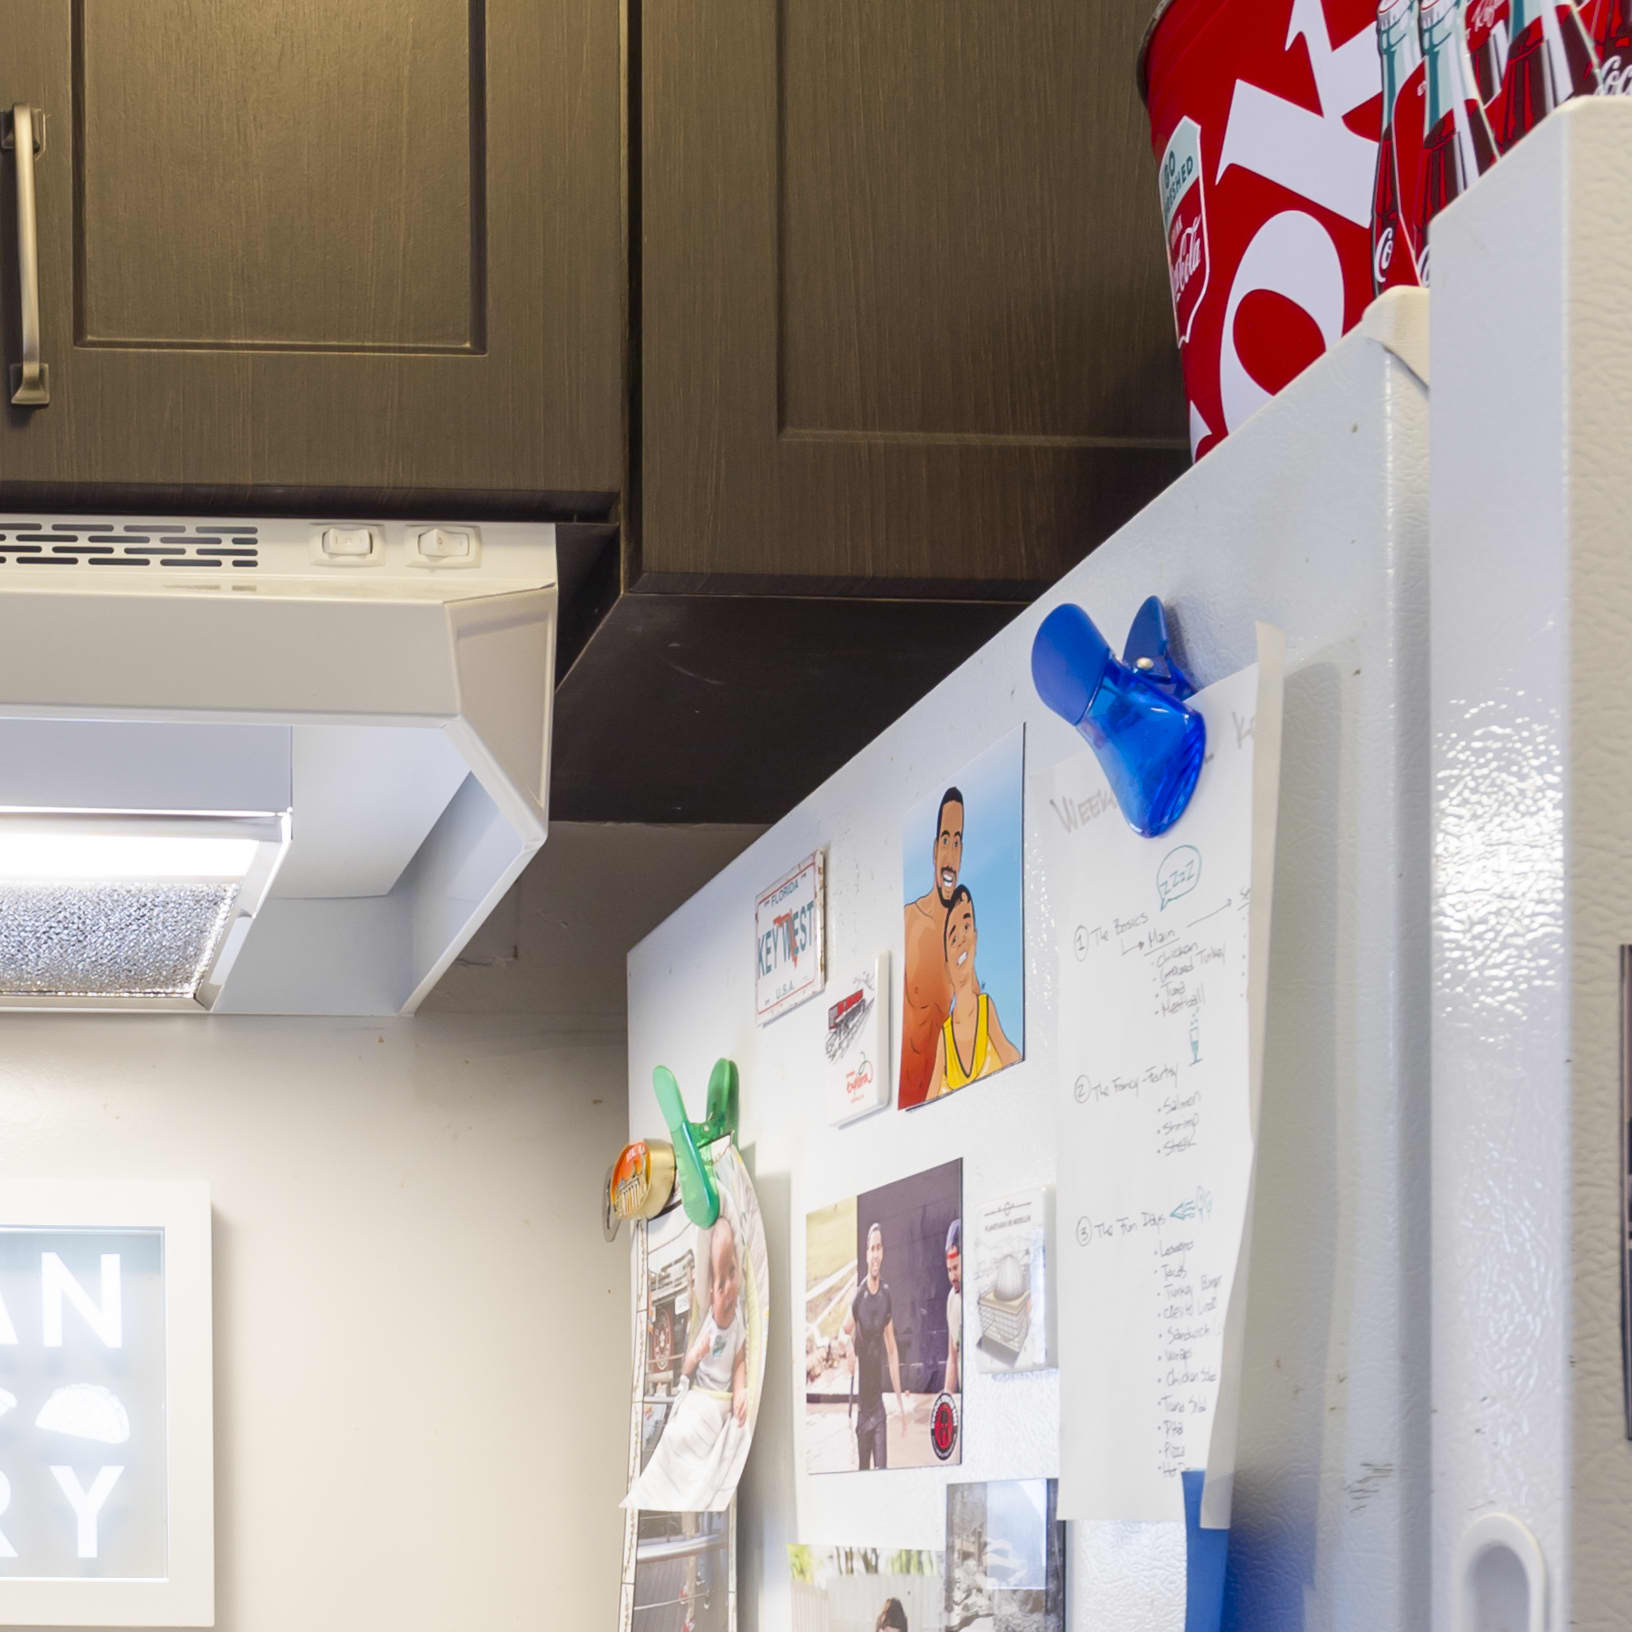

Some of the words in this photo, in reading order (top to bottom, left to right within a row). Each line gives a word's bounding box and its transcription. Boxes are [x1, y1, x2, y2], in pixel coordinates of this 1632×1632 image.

[770, 878, 799, 907] FLORIDA
[758, 923, 779, 977] KEY
[781, 900, 815, 963] WEST
[1089, 926, 1109, 946] The
